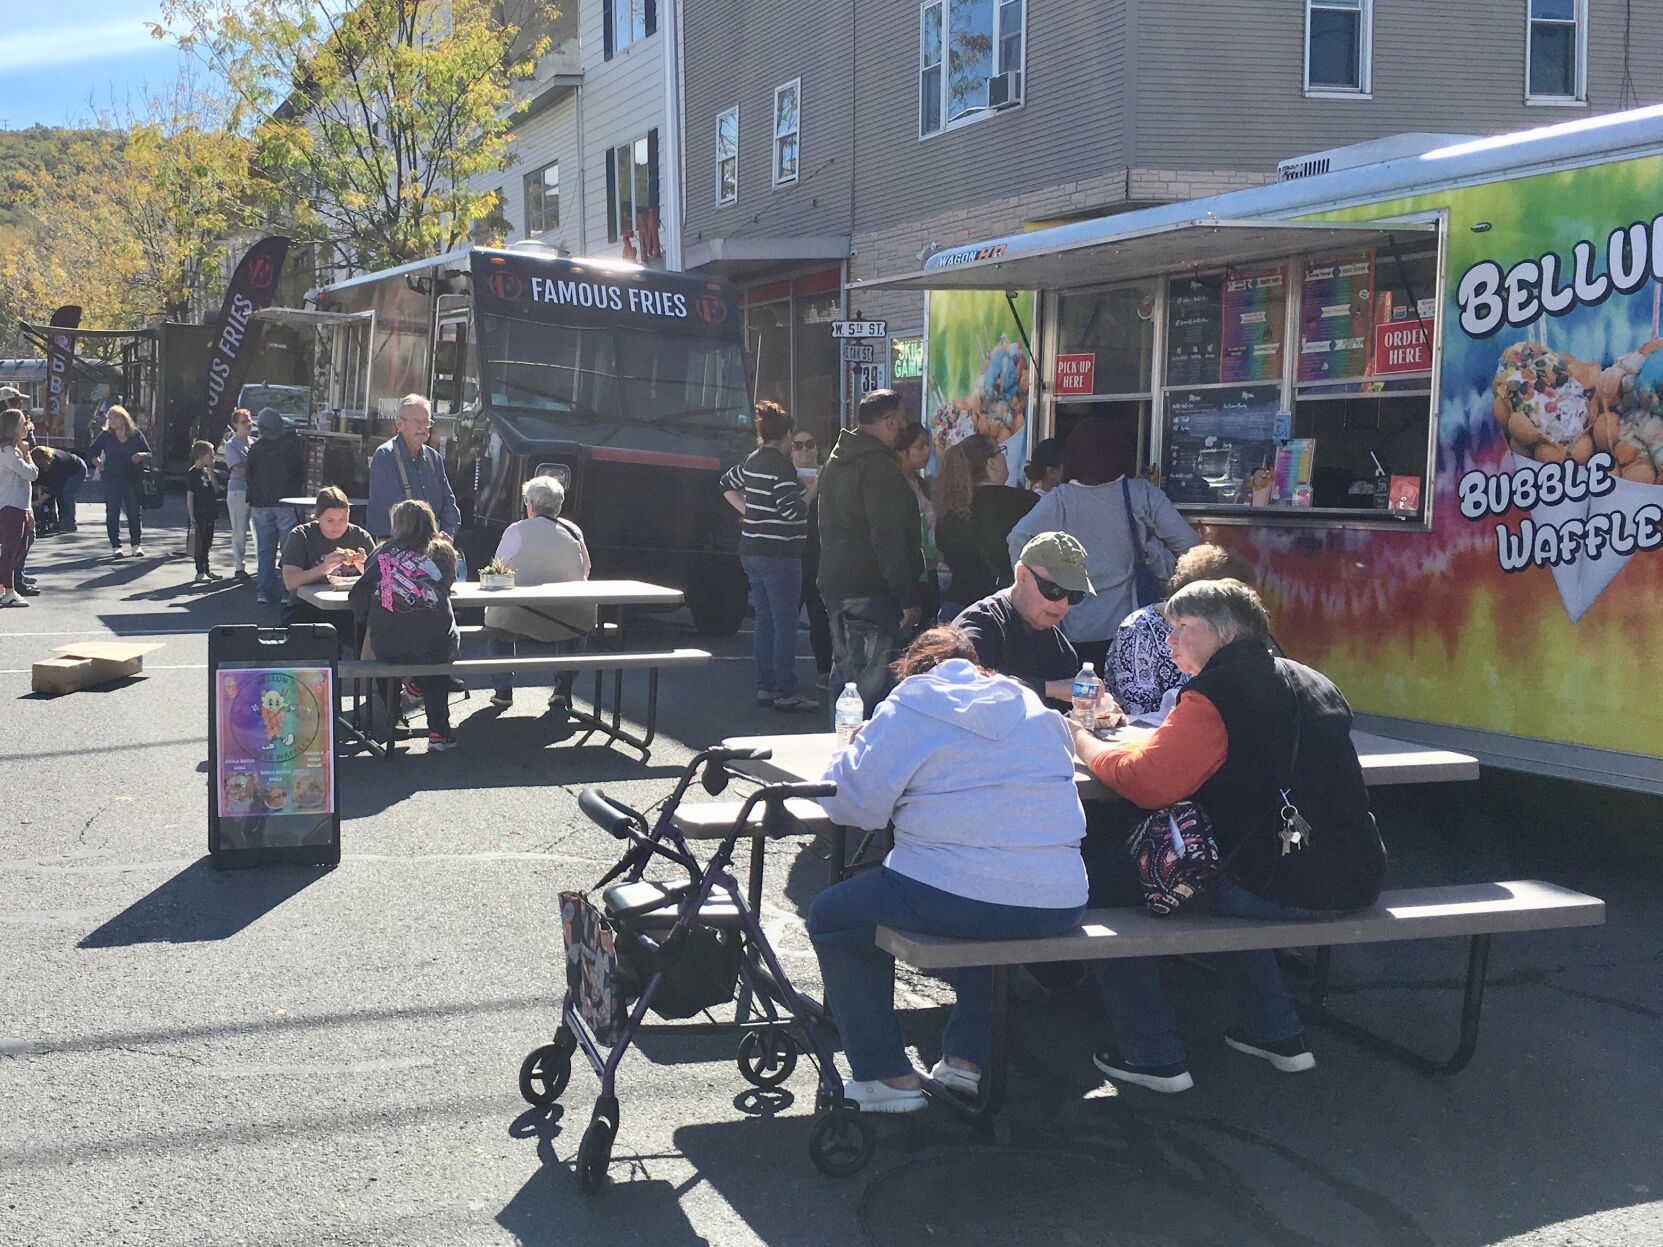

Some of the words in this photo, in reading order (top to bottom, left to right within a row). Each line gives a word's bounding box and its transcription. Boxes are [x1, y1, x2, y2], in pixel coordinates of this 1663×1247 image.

[939, 251, 978, 268] WAGON
[531, 277, 622, 311] FAMOUS
[628, 288, 688, 318] FRIES
[219, 293, 253, 359] FRIES
[835, 323, 844, 336] W.
[848, 323, 864, 335] 5TH
[868, 323, 883, 336] ST.
[1384, 328, 1428, 348] ORDER
[1389, 346, 1423, 365] HERE
[1058, 360, 1091, 374] PICK-UP
[1063, 375, 1084, 388] HERE
[1458, 452, 1615, 519] BUBBLE
[1496, 503, 1663, 574] WAFFLE
